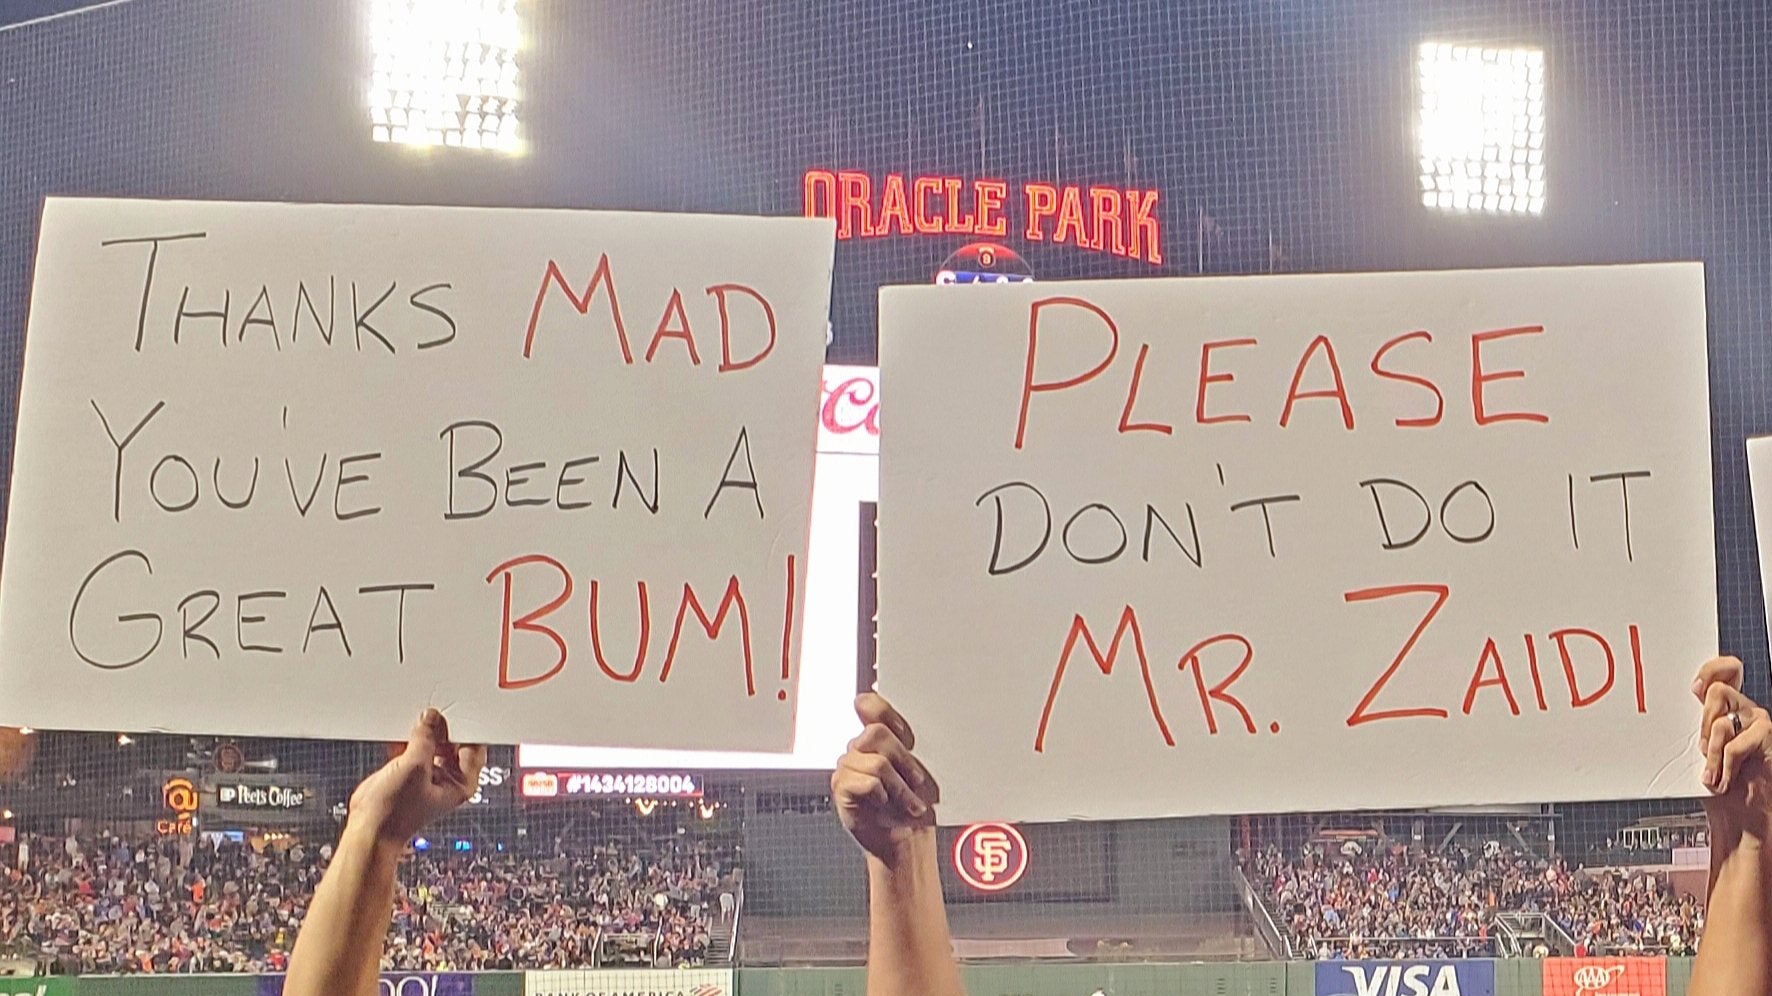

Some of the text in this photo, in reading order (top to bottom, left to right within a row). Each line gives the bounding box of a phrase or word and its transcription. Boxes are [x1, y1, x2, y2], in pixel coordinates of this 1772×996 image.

[804, 170, 1163, 265] ORACLE PARK
[102, 232, 775, 372] THANKS MAD
[1015, 297, 1548, 449] PLEASE
[91, 400, 764, 522] YOU'VE BEEN A
[976, 463, 1651, 575] DON'T DO IT
[70, 550, 794, 700] GREAT BUM!
[1035, 585, 1646, 753] MR. ZAIDI
[269, 786, 303, 808] Coffee
